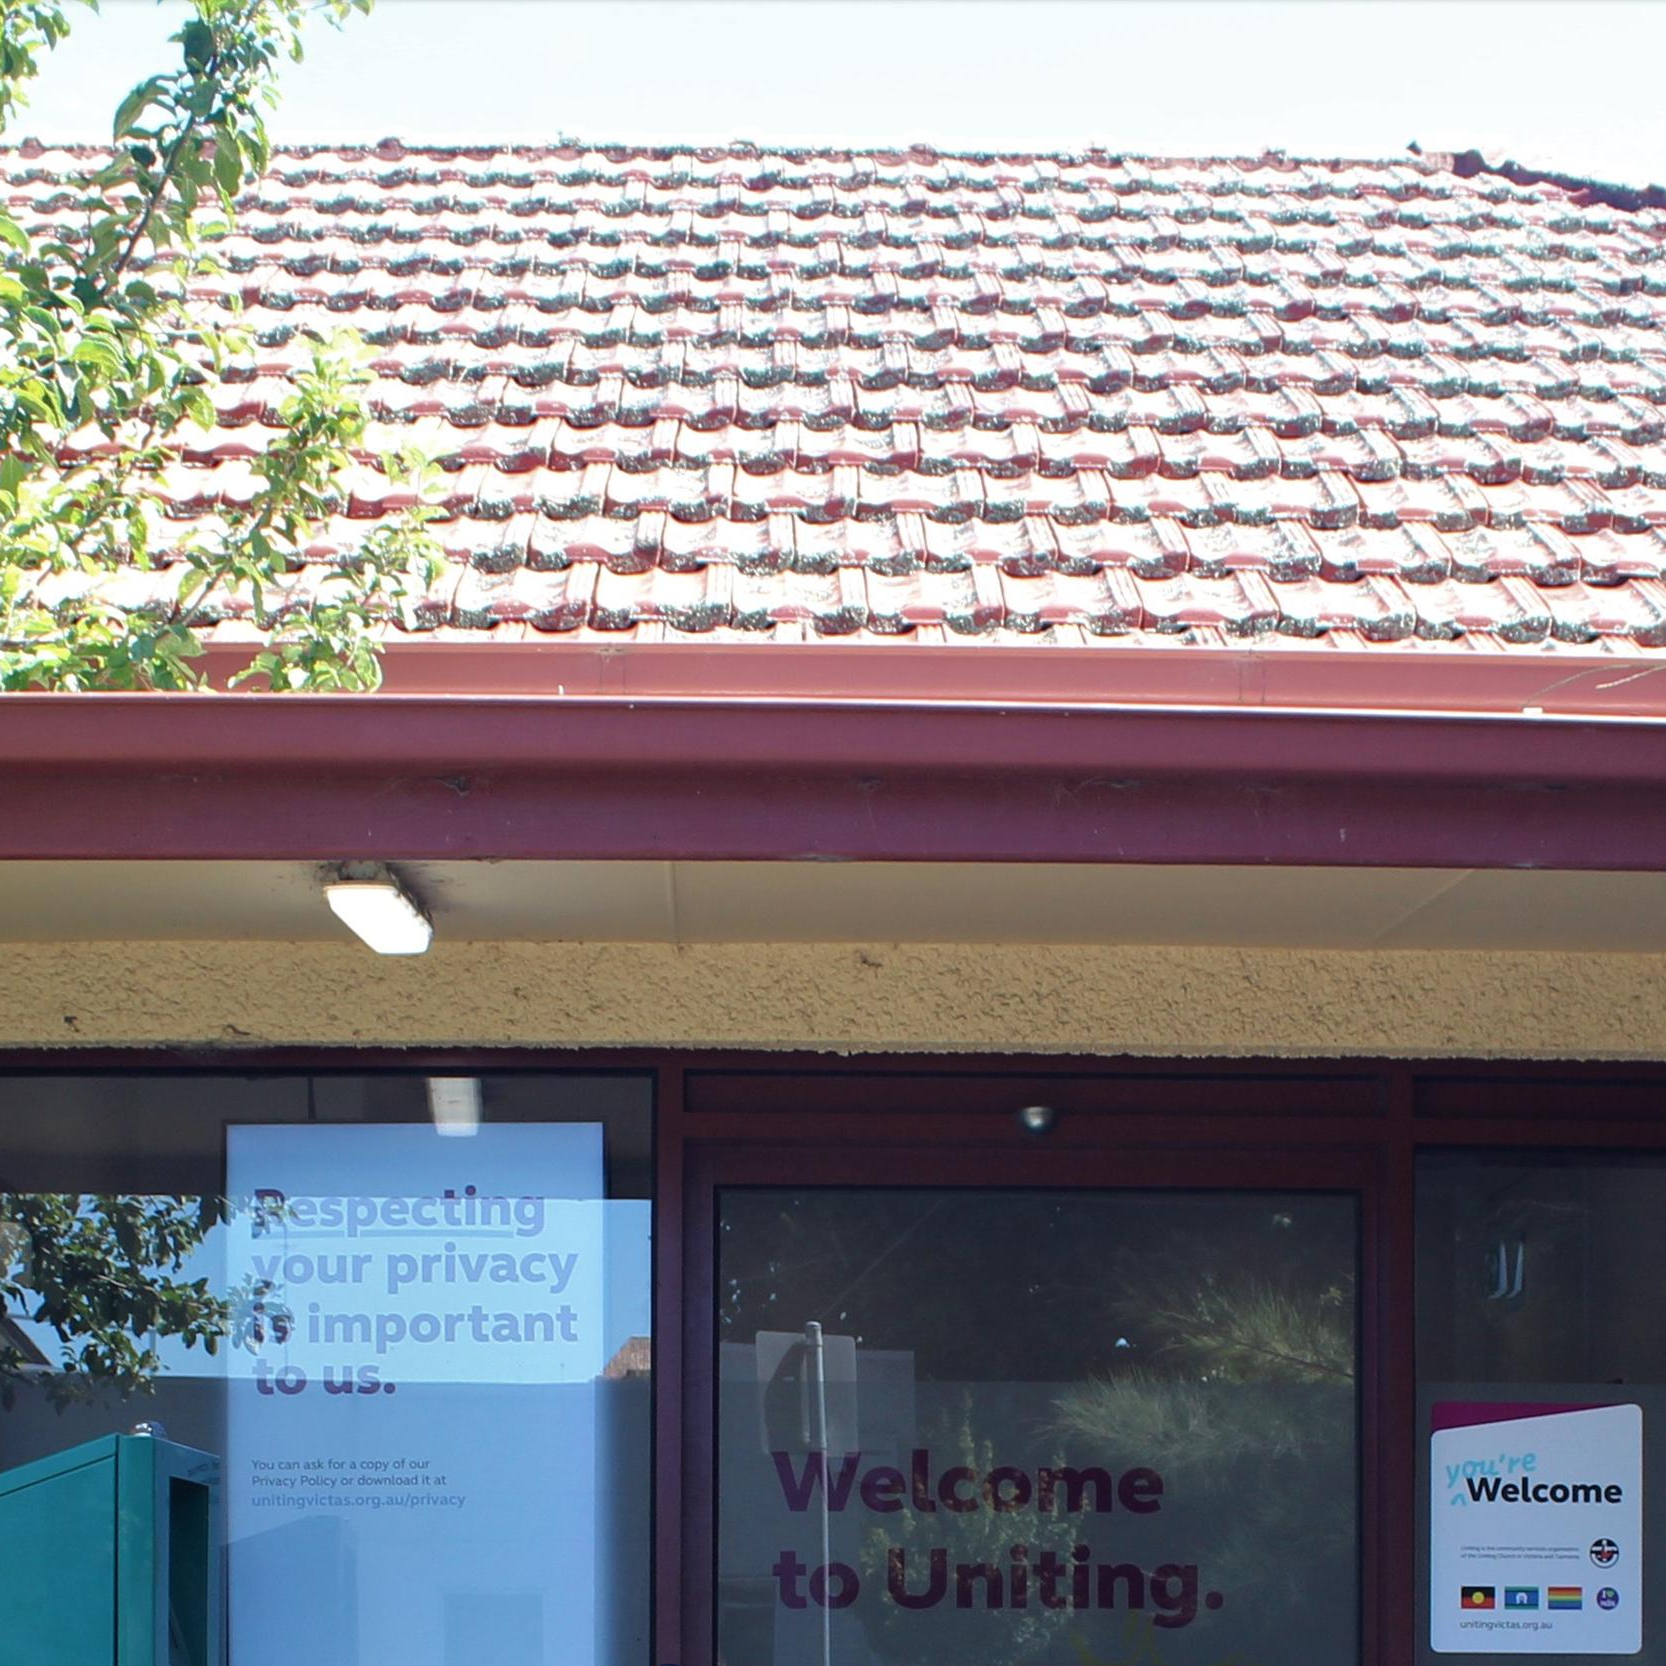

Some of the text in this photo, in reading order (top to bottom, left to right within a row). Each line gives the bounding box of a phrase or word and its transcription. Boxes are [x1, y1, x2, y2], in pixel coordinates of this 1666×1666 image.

[253, 1184, 546, 1238] Respecting
[251, 1241, 579, 1294] your privacy
[253, 1301, 579, 1354] is important
[253, 1358, 396, 1396] to us.
[251, 1458, 430, 1473] You can ask for a copy of our
[252, 1475, 446, 1489] Privacy Policy or download it at
[772, 1449, 1164, 1514] Welcome
[1446, 1452, 1537, 1488] you're
[252, 1493, 466, 1509] unitingvictas.org.au/privacy
[1466, 1477, 1623, 1504] Welcome
[771, 1543, 1225, 1628] to Uniting.
[1460, 1619, 1553, 1631] unitingvictas.org.au
